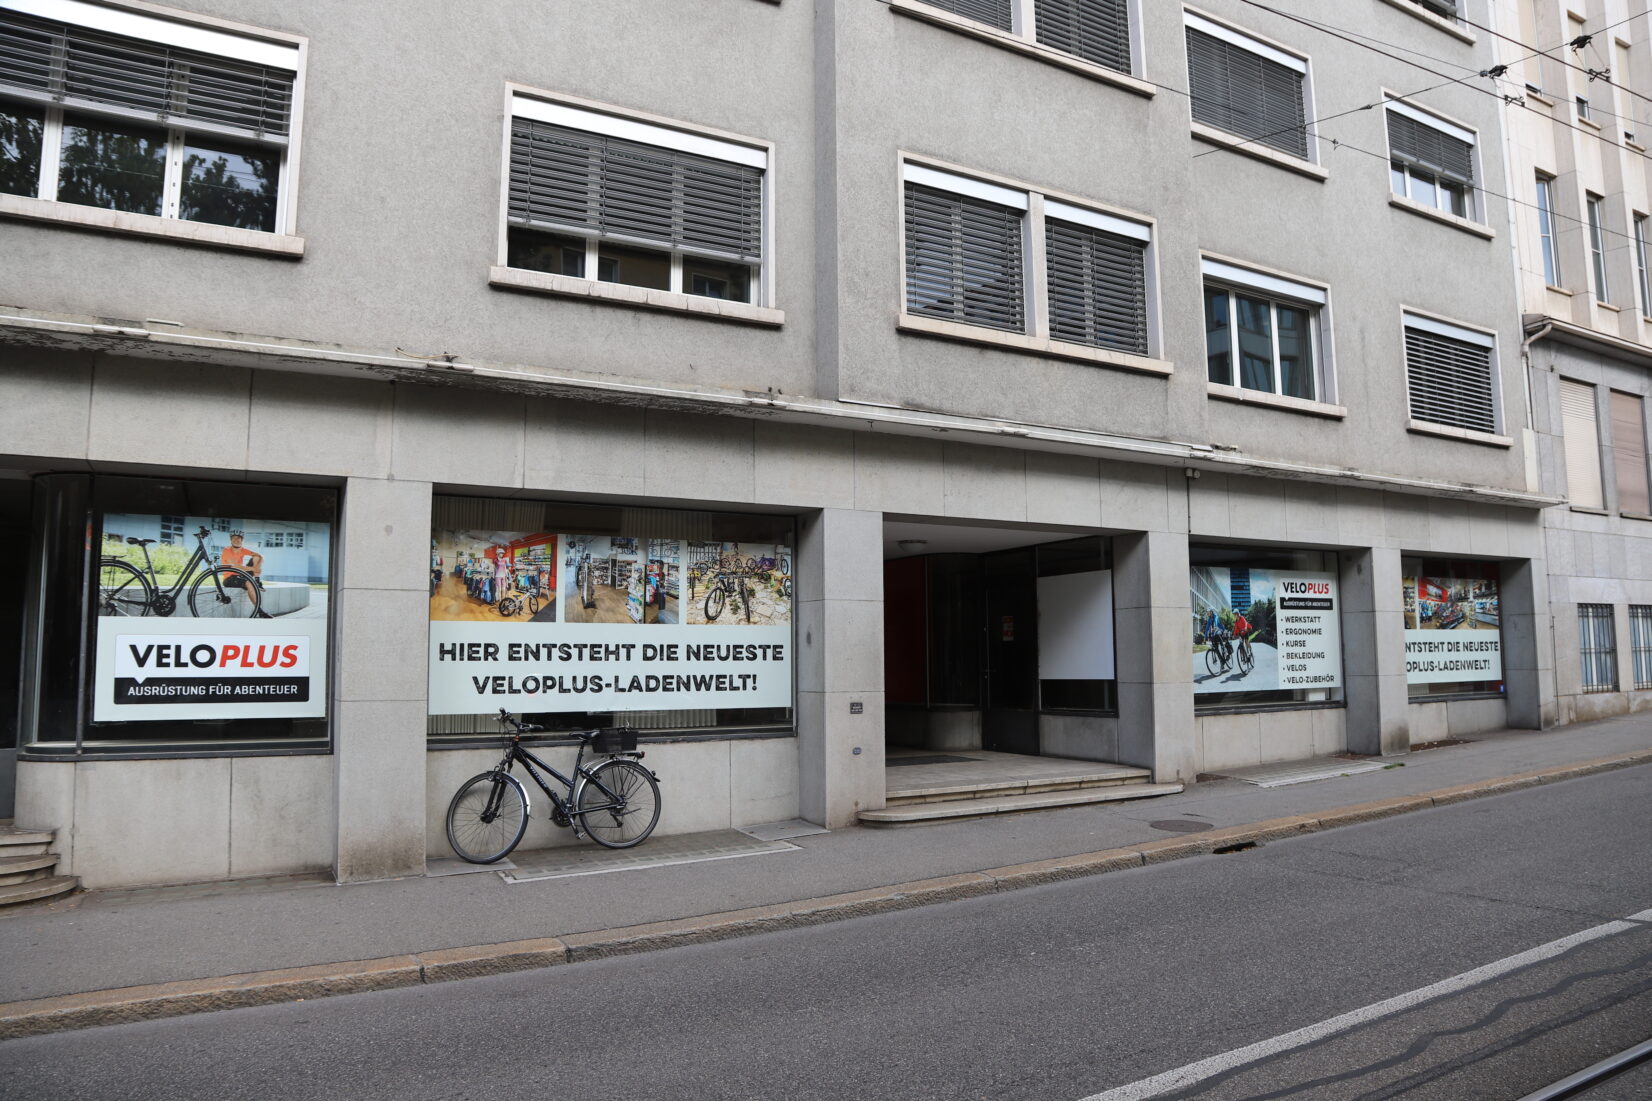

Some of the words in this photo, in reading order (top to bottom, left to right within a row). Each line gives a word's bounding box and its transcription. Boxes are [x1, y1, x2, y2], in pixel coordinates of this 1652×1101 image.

[1283, 582, 1329, 594] VELOPLUS
[439, 643, 499, 661] HIER
[508, 643, 635, 661] ENTSTEHT
[643, 644, 678, 661] DIE
[687, 644, 783, 661] NEUESTE
[1405, 641, 1445, 653] NTSTEHT
[1447, 642, 1460, 652] DIE
[1463, 641, 1499, 651] NEUESTE
[129, 644, 298, 668] VELOPLUS
[1286, 652, 1325, 660] BEKLEIDUNG
[1406, 660, 1490, 672] OPLUS-LADENWELT!
[472, 674, 757, 694] VELOPLUS-LADENWELT!
[1287, 674, 1335, 684] VELO-ZUBEHÖR
[127, 684, 206, 696] AUSRÜSTUNG
[209, 683, 231, 695] FÜR
[234, 684, 298, 695] ABENTEUER
